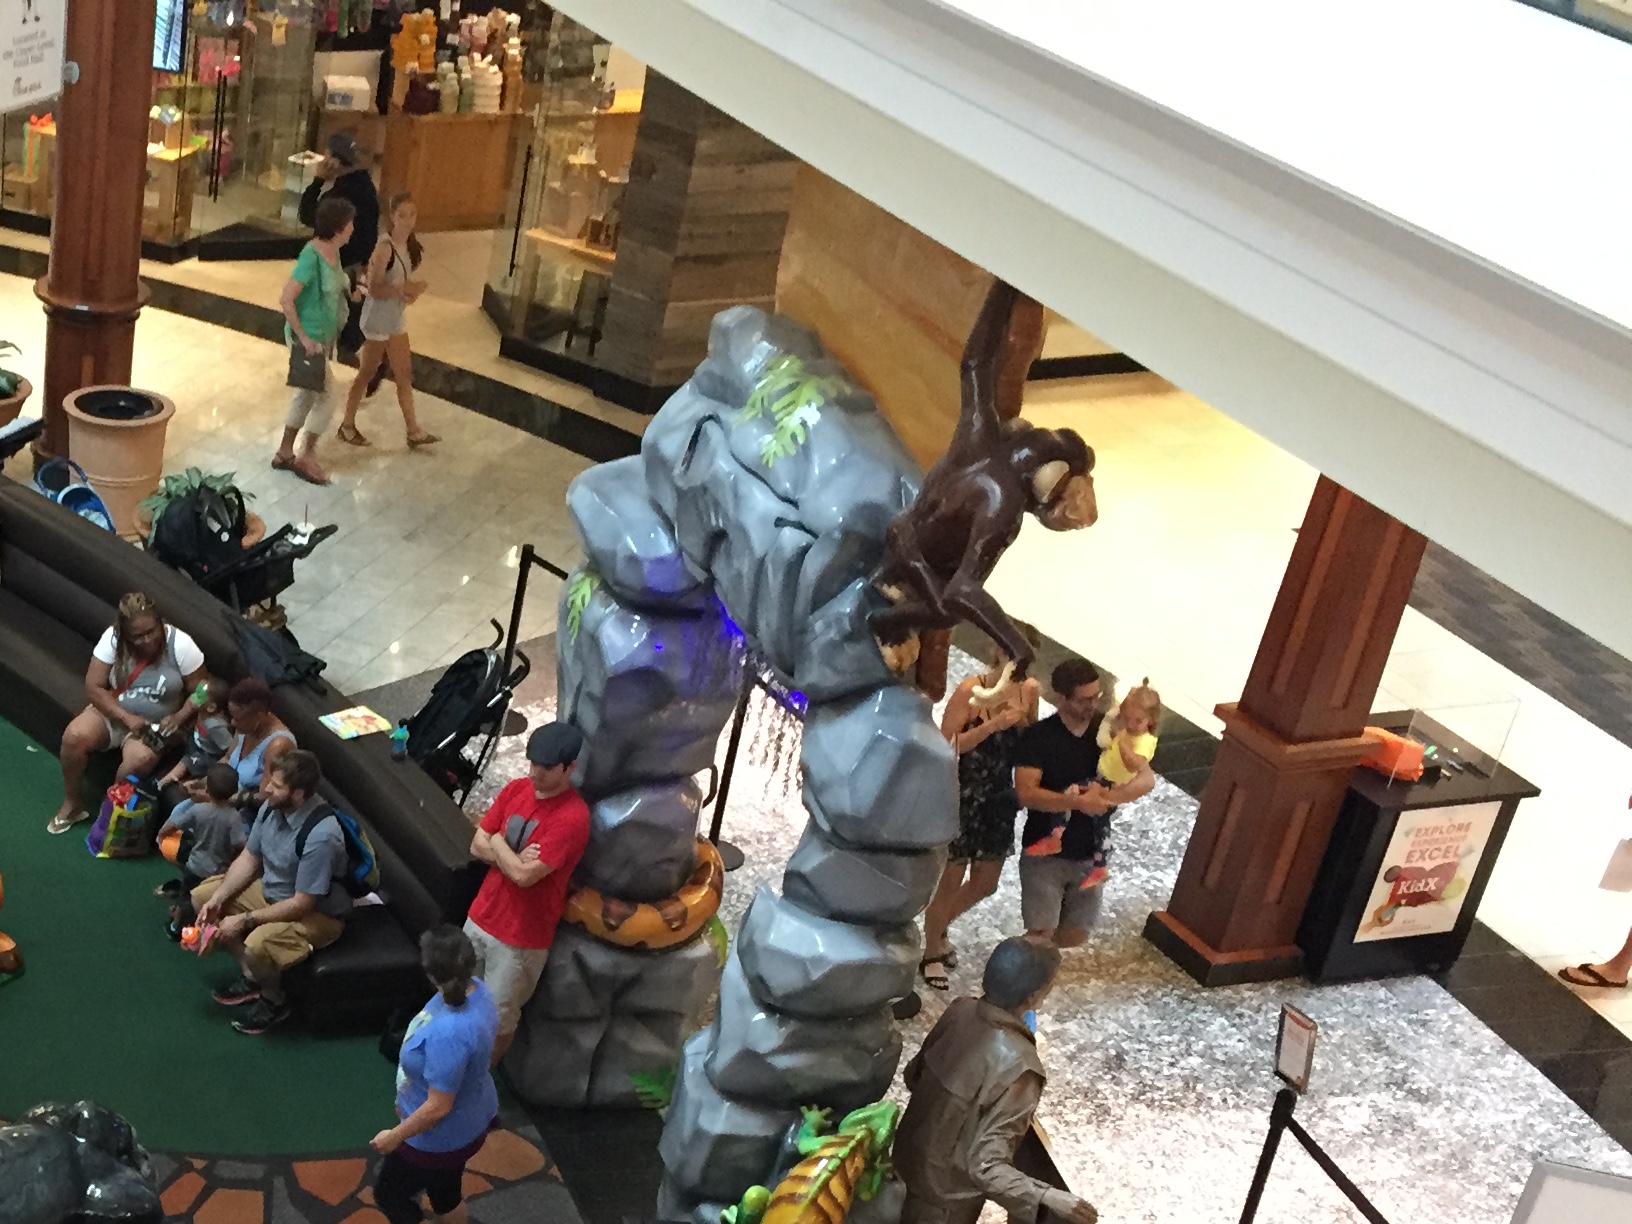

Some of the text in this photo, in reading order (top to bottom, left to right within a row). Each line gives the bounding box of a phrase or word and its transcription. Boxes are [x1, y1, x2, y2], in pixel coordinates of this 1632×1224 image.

[1414, 821, 1472, 838] EXPLORE
[1404, 844, 1459, 864] EXCEL
[1396, 877, 1440, 895] KidX
